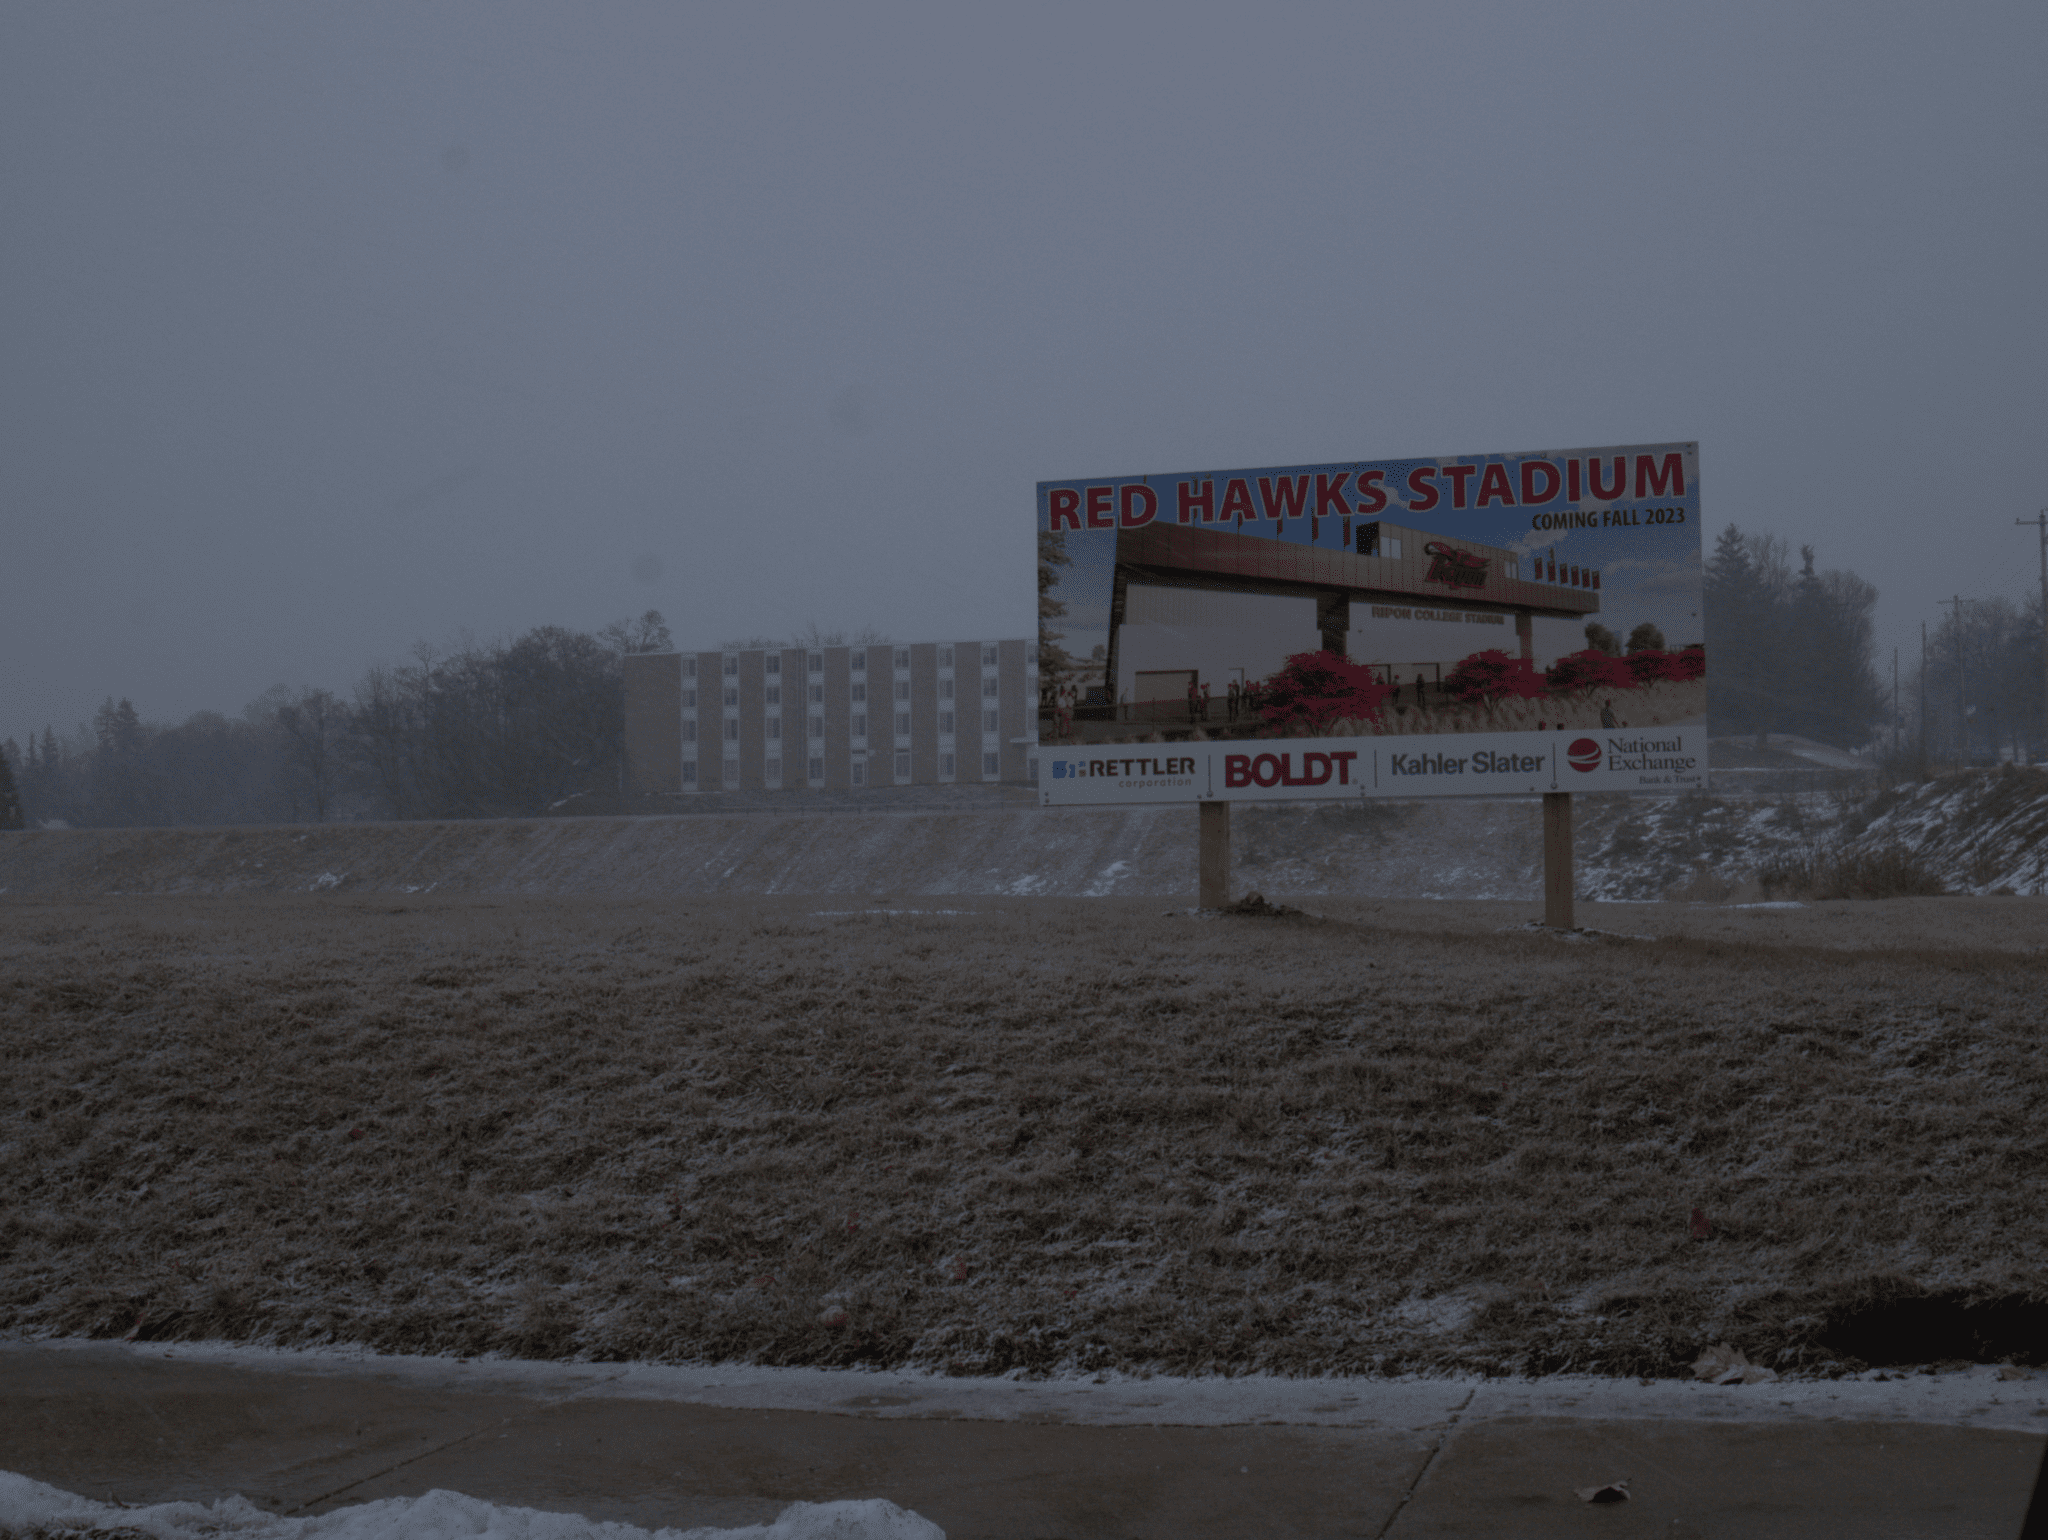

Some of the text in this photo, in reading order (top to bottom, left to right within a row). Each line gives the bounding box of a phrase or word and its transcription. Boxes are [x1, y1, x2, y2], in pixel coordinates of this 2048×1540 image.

[1049, 453, 1687, 532] RED HAWKS STADIUM
[1532, 507, 1686, 531] COMING FALL 2023
[1608, 736, 1682, 754] National
[1089, 757, 1196, 777] RETTLER
[1225, 751, 1358, 787] BOLDT
[1391, 750, 1545, 776] Kahler Slater
[1608, 753, 1696, 773] Exchange
[1118, 777, 1192, 789] corporation
[1639, 775, 1661, 784] Bank
